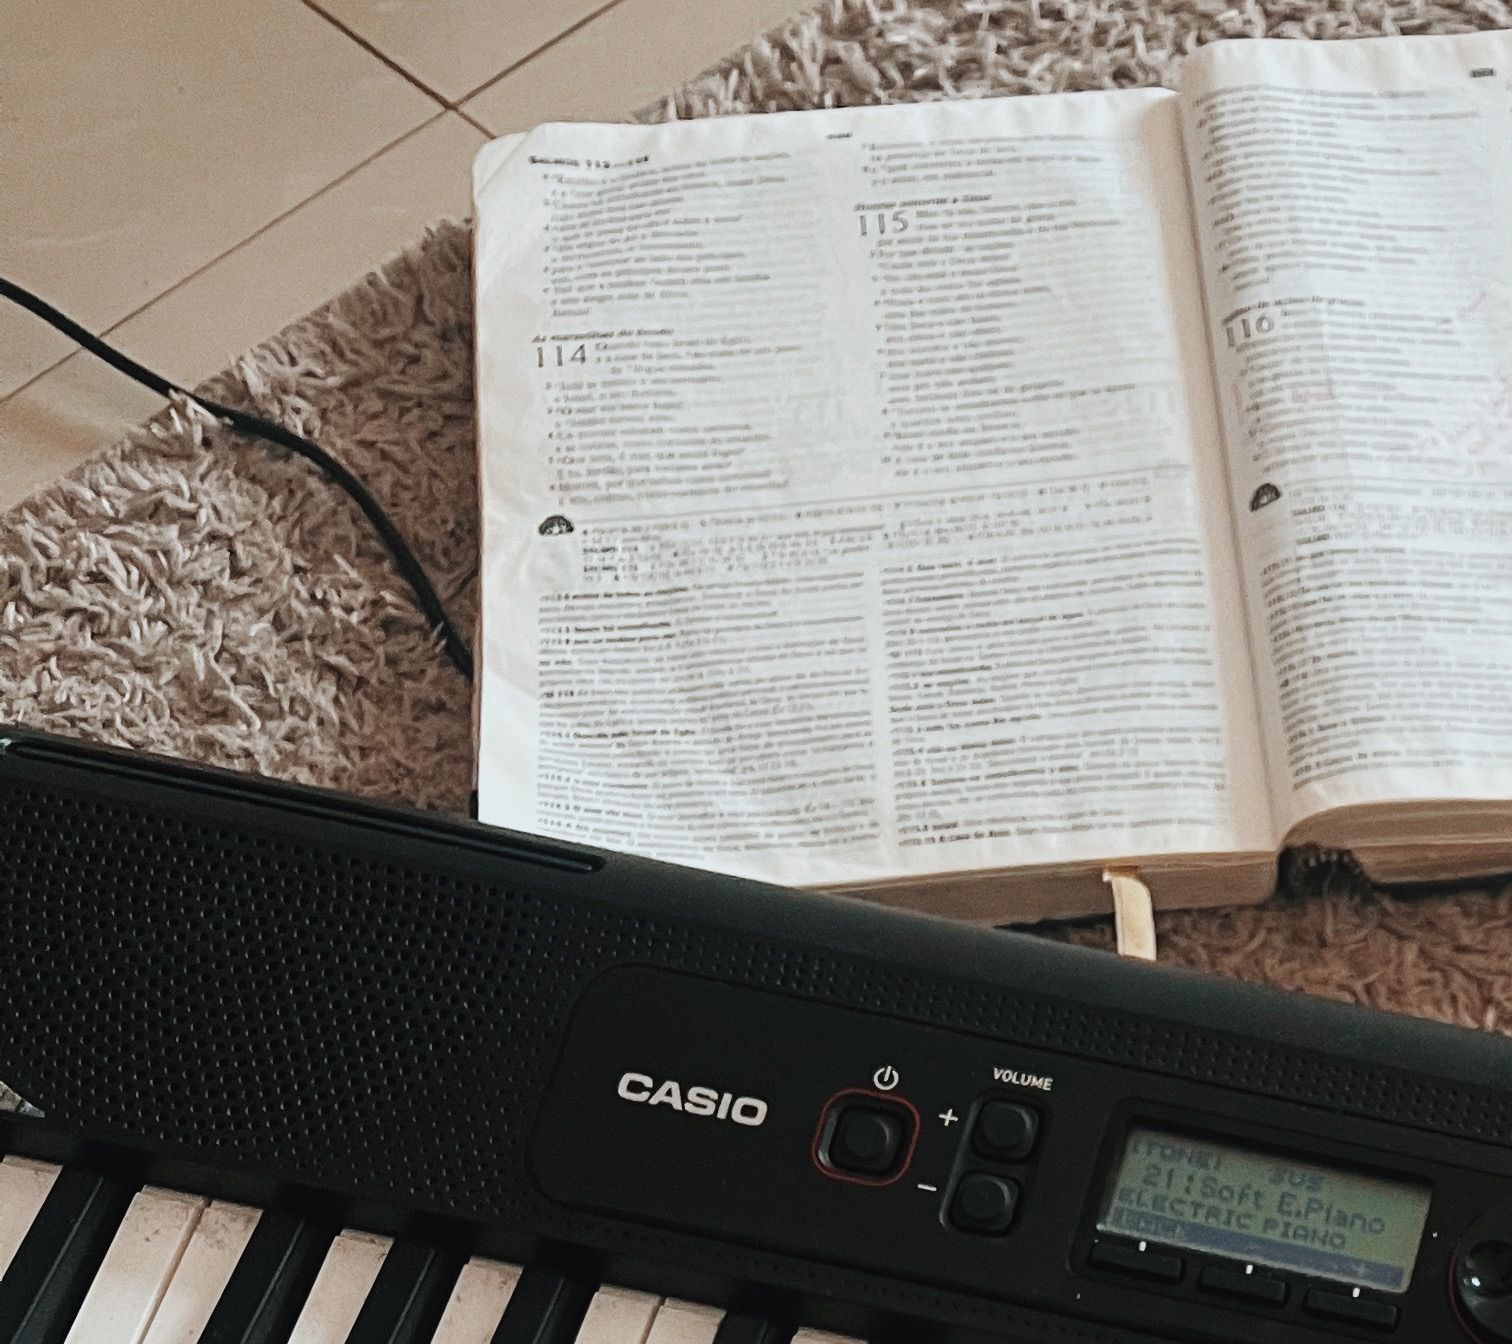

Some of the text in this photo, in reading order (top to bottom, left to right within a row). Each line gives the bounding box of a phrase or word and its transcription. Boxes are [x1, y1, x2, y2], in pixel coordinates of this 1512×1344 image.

[992, 1066, 1054, 1092] VOLUME
[617, 1071, 769, 1127] CASIO
[1118, 1185, 1255, 1231] ELECTRIC
[1262, 1217, 1346, 1250] PIANO
